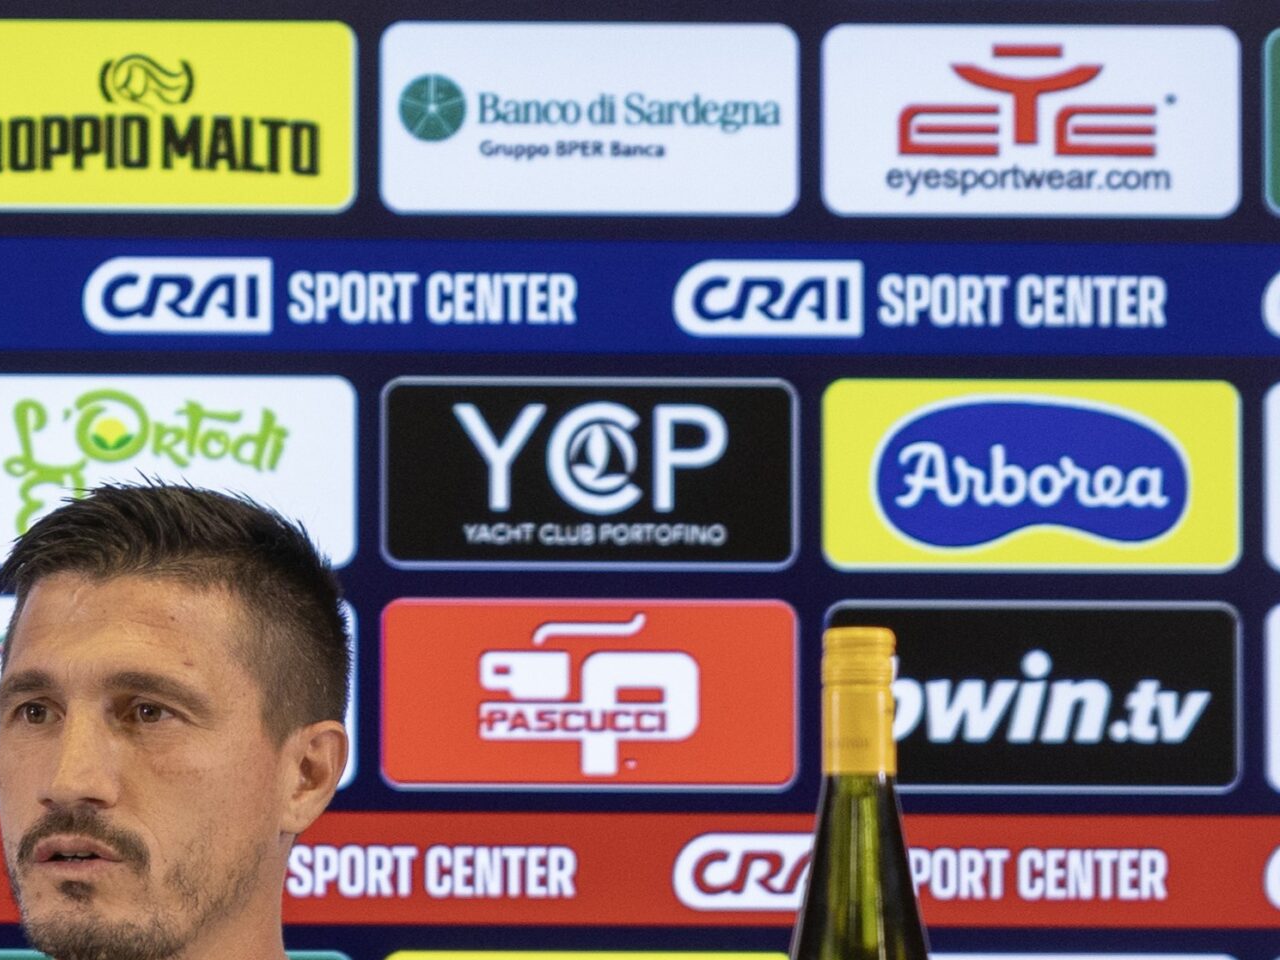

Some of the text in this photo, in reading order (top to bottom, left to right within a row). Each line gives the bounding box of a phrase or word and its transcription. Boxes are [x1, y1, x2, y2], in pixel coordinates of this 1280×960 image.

[478, 92, 781, 133] Banco di Sardegna
[160, 115, 322, 177] MALTO
[479, 140, 666, 160] Gruppo BPER Banca
[885, 164, 1172, 196] eyesportwear.com
[99, 269, 578, 325] CRAI SPORT CENTER
[690, 273, 1168, 329] CRAI SPORT CENTER
[452, 401, 730, 515] YCP
[895, 441, 1170, 508] Arborea
[463, 523, 727, 546] YACHT CLUB PORTOFINO
[484, 708, 668, 733] PASCUCCI
[286, 844, 578, 898] SPORT CENTER
[691, 847, 1168, 901] CR PORT CENTER
